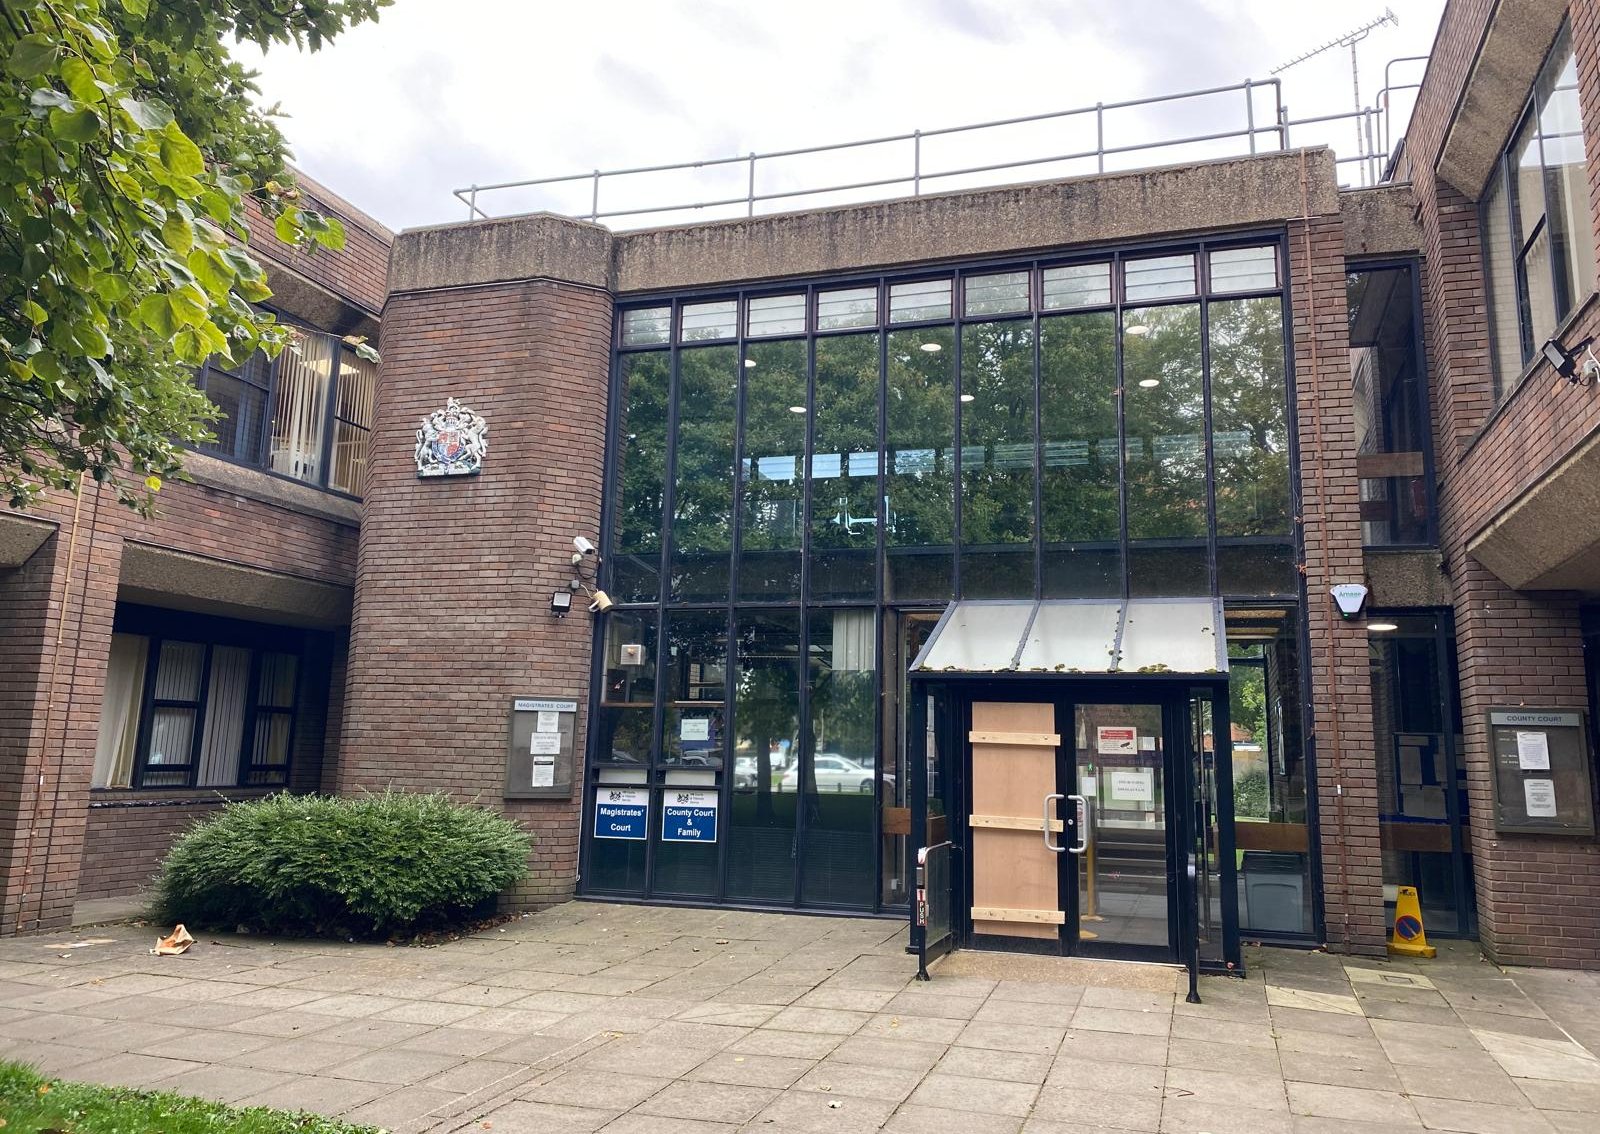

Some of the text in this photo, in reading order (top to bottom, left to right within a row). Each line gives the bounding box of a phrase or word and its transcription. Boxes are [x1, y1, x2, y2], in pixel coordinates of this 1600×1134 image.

[600, 807, 644, 817] Magistrates'
[667, 808, 714, 818] County Court
[610, 823, 631, 831] Court
[686, 818, 693, 826] &
[677, 828, 701, 838] Family
